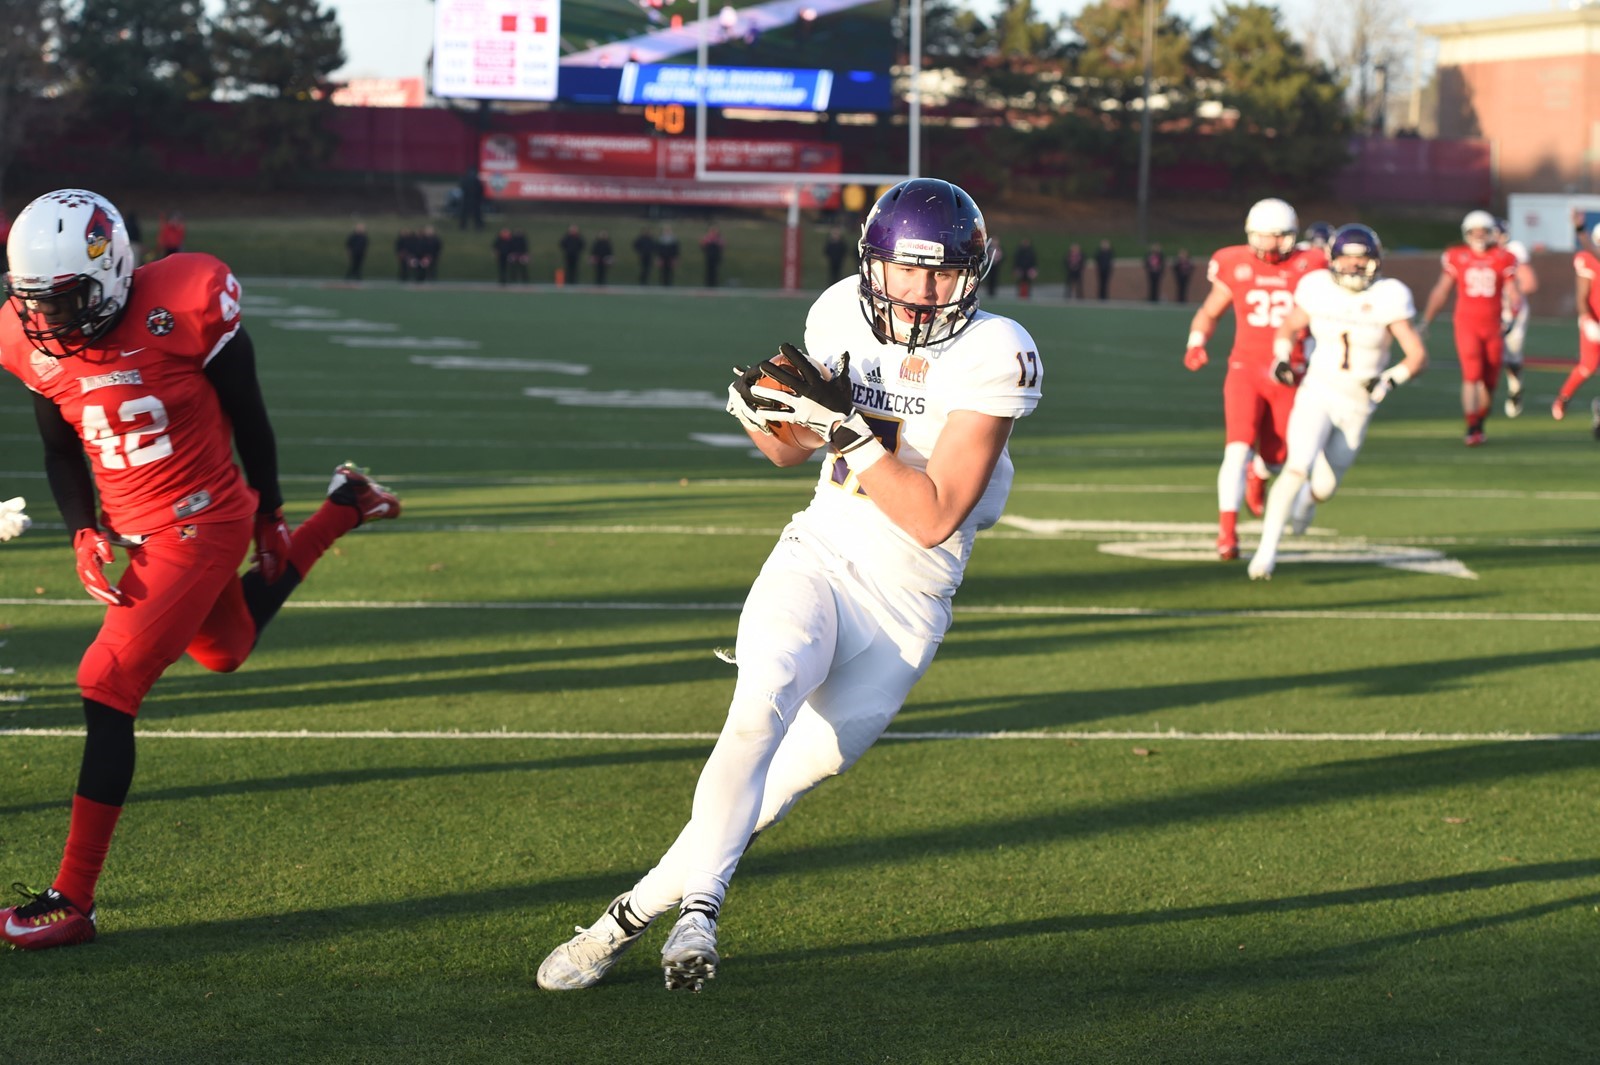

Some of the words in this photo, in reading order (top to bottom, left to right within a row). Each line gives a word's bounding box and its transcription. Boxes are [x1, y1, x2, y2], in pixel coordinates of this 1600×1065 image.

[645, 104, 685, 134] 40
[1245, 289, 1295, 327] 32
[1340, 331, 1354, 370] 1
[864, 375, 884, 384] adidas
[1015, 351, 1038, 388] 17
[81, 395, 174, 470] 42
